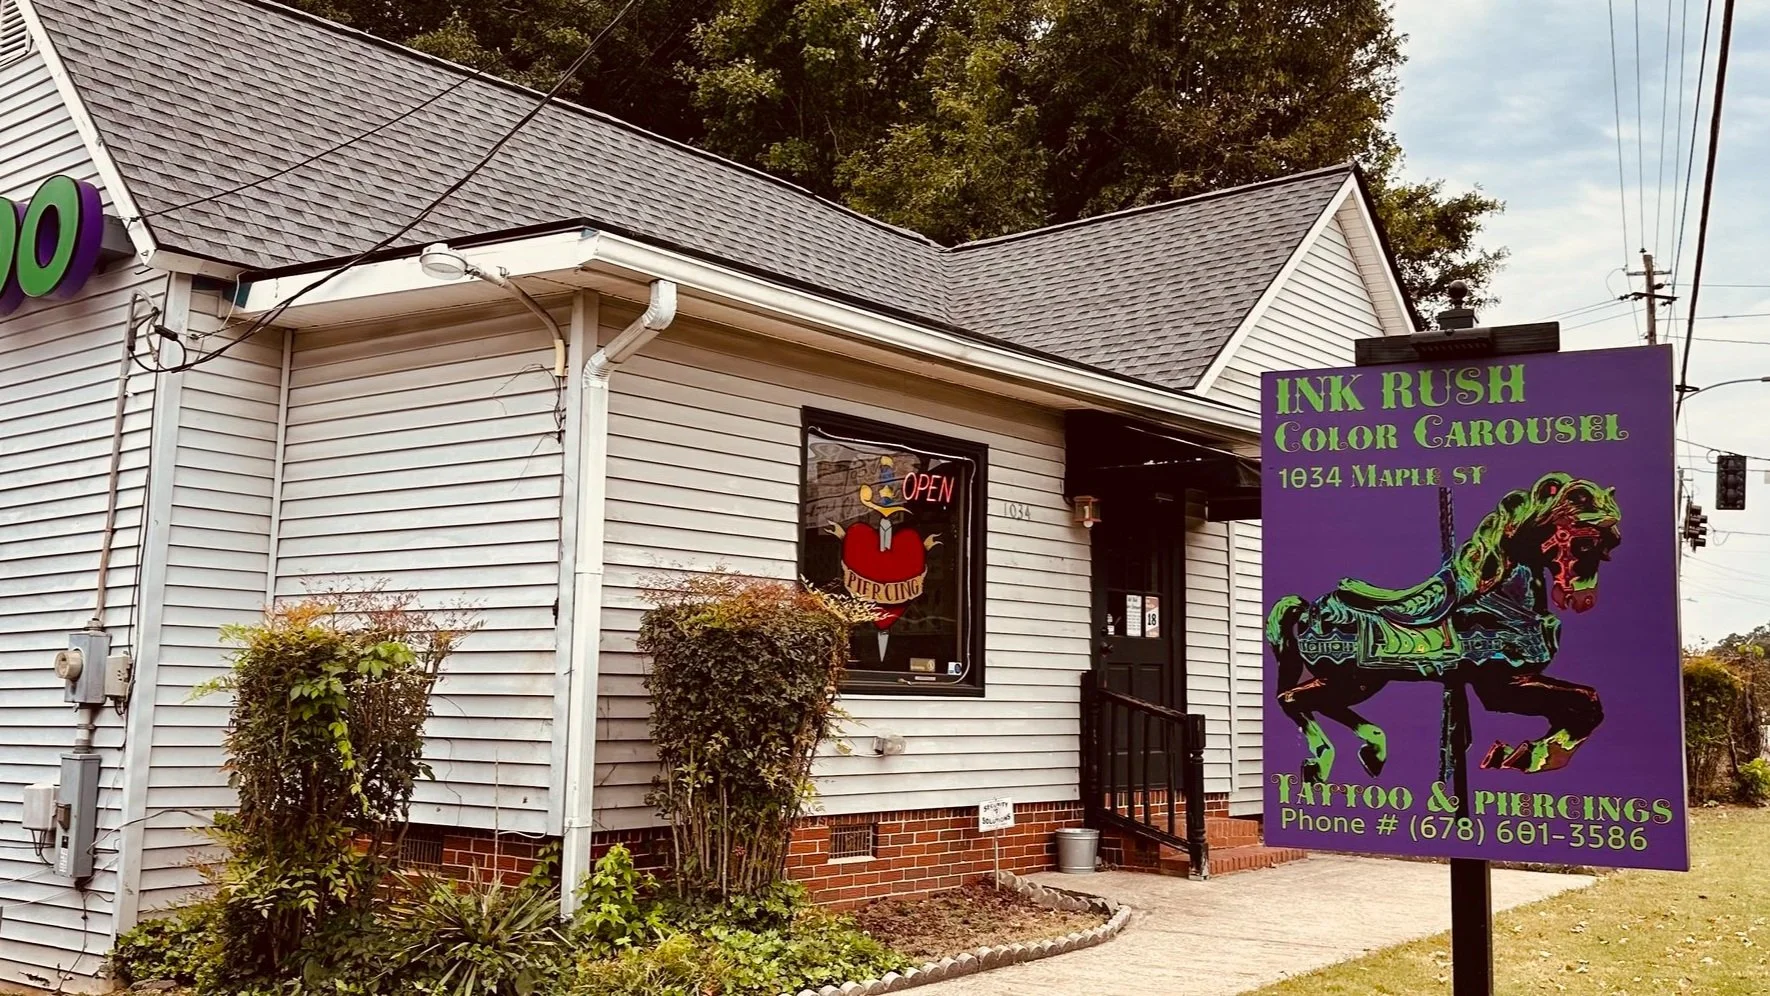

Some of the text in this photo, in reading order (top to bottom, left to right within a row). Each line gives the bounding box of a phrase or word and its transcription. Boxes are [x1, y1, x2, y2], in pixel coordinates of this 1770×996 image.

[1275, 363, 1526, 415] INK RUSH
[1274, 413, 1630, 453] COLOR CAROUSEL
[902, 471, 956, 504] OPEN
[1279, 466, 1343, 489] 1034
[1350, 464, 1442, 488] MAPLE
[1003, 502, 1031, 520] 1034
[847, 571, 920, 602] PIERCING
[1146, 612, 1158, 626] 18
[1270, 773, 1674, 825] TATTOO & PIERCINGS
[1280, 808, 1649, 852] Phone # (678) 601-3586
